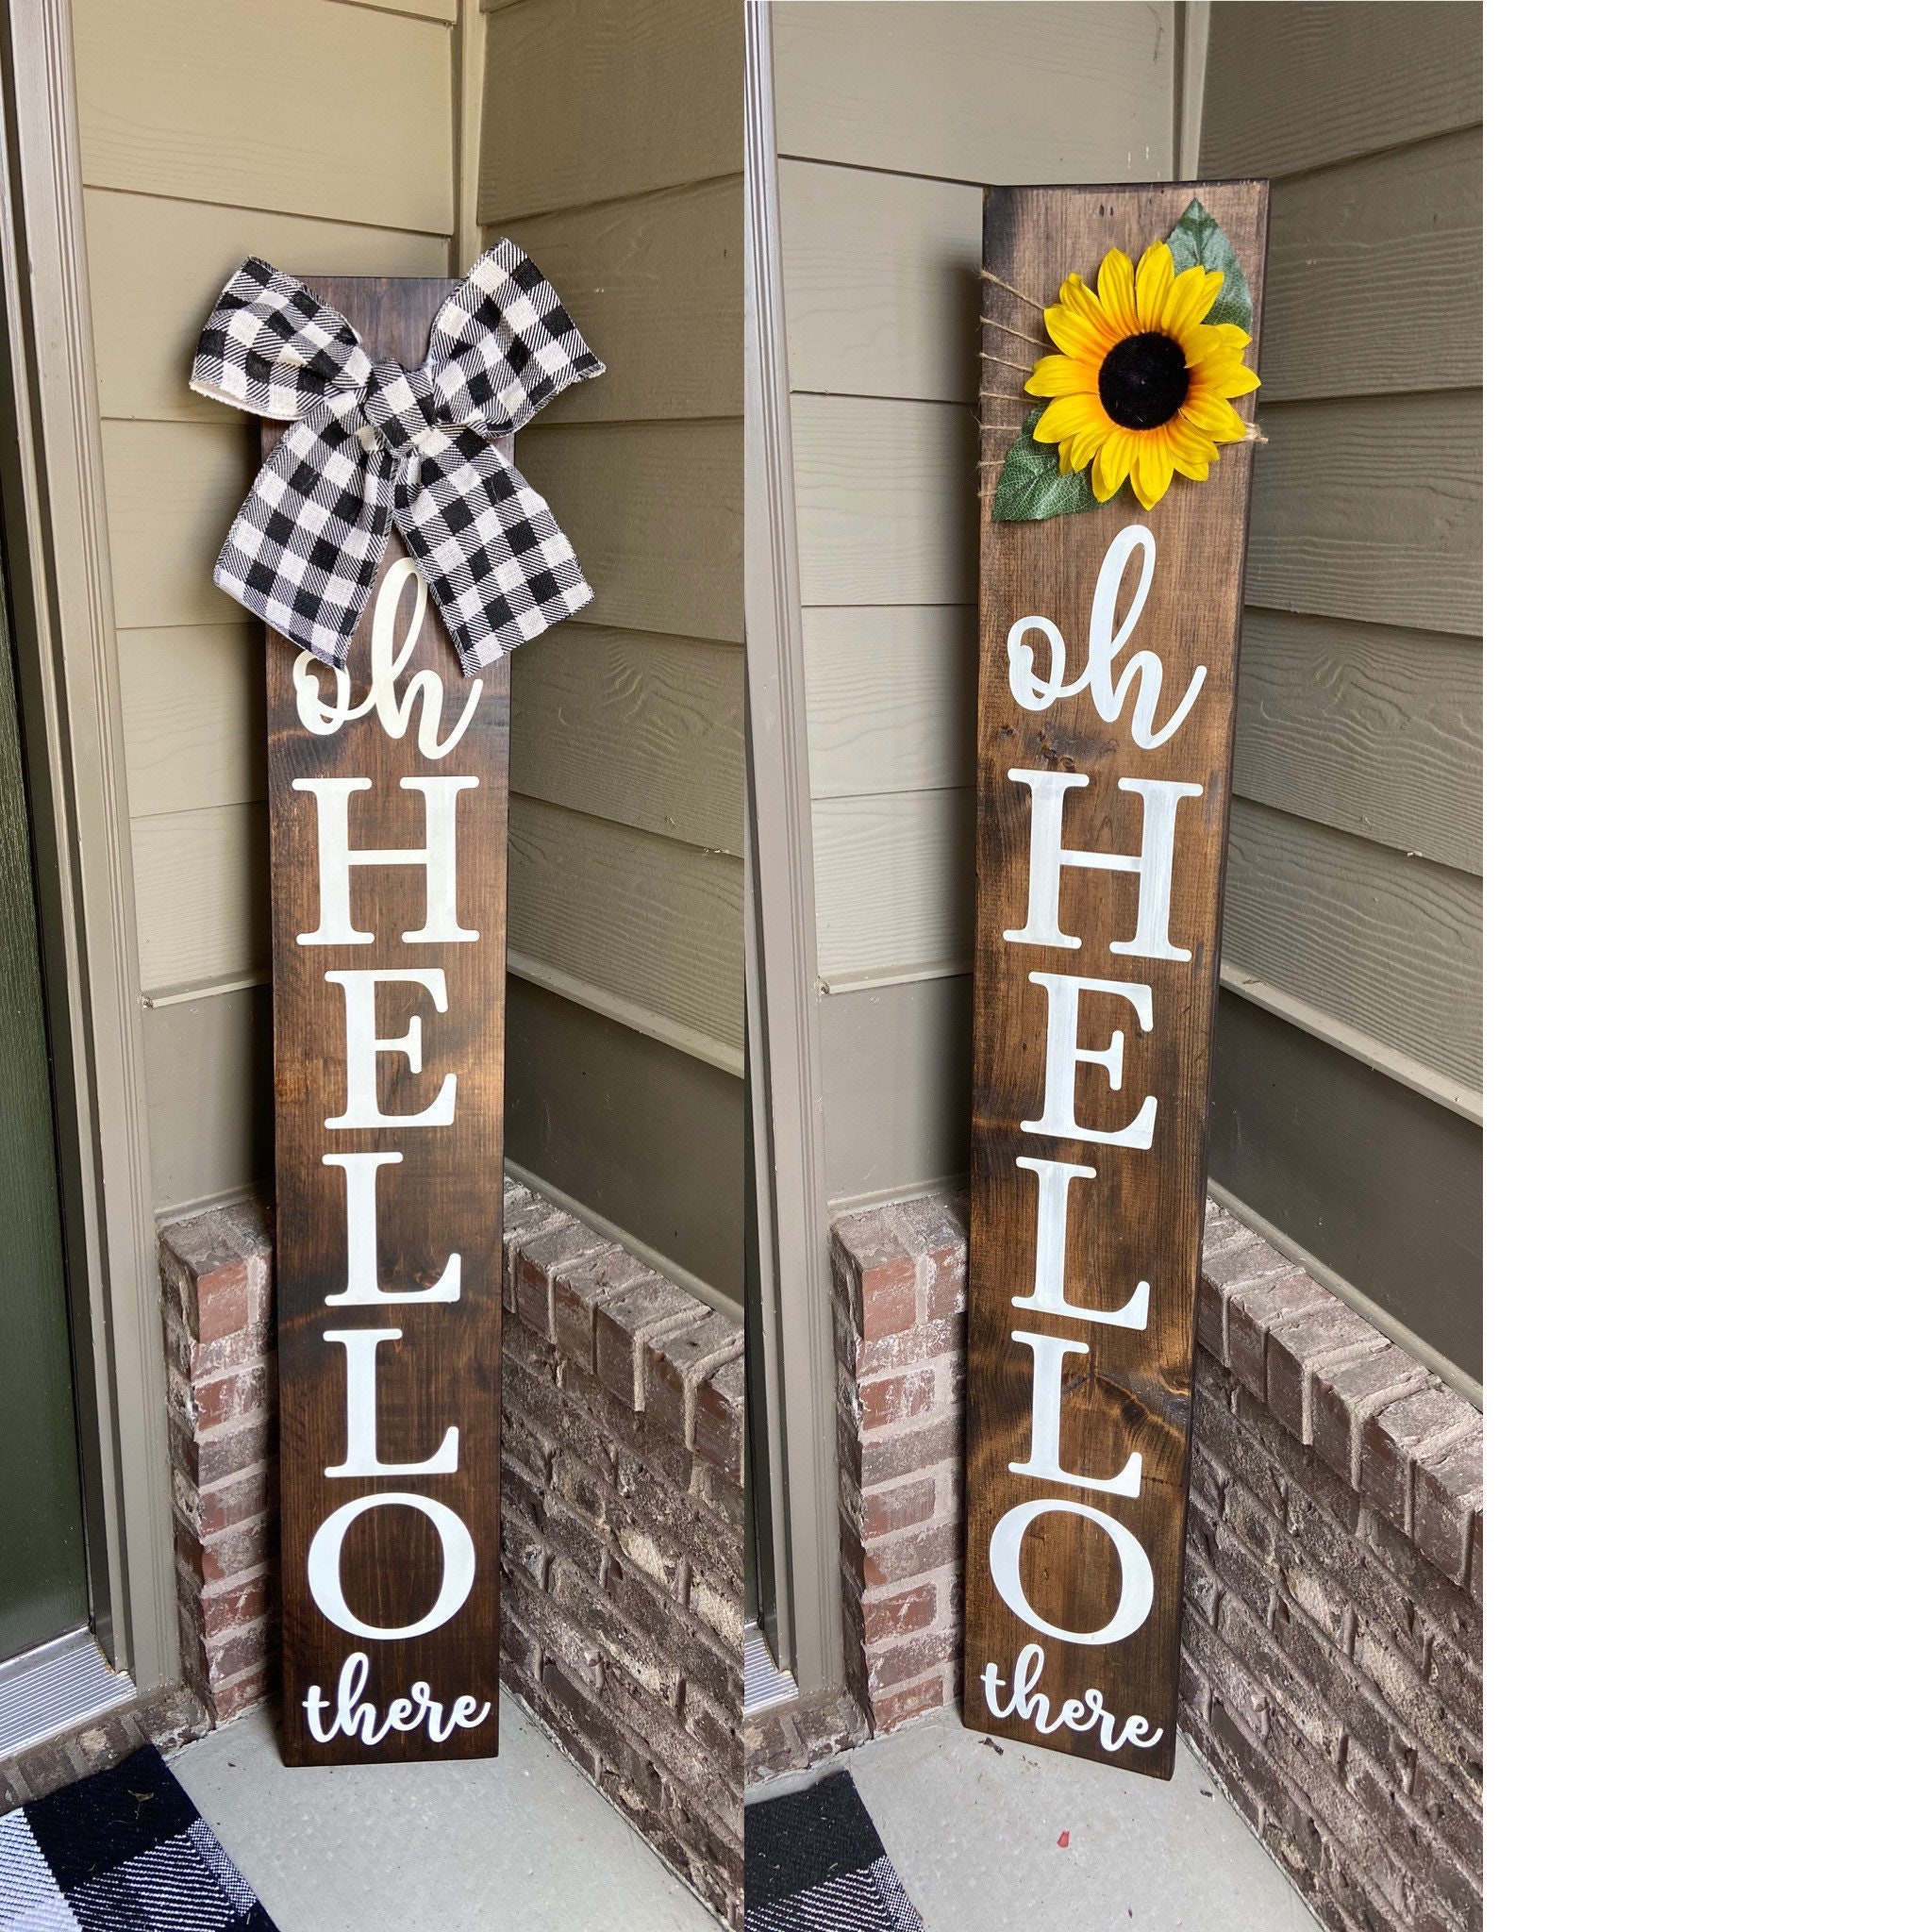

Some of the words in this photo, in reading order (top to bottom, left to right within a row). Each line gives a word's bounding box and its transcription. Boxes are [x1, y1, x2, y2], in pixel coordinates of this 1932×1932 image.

[291, 557, 483, 759] oh
[1007, 524, 1208, 750] oh
[291, 775, 480, 1641] HELLO
[988, 767, 1204, 1645] HELLO
[301, 1651, 492, 1747] there
[980, 1642, 1164, 1753] there
